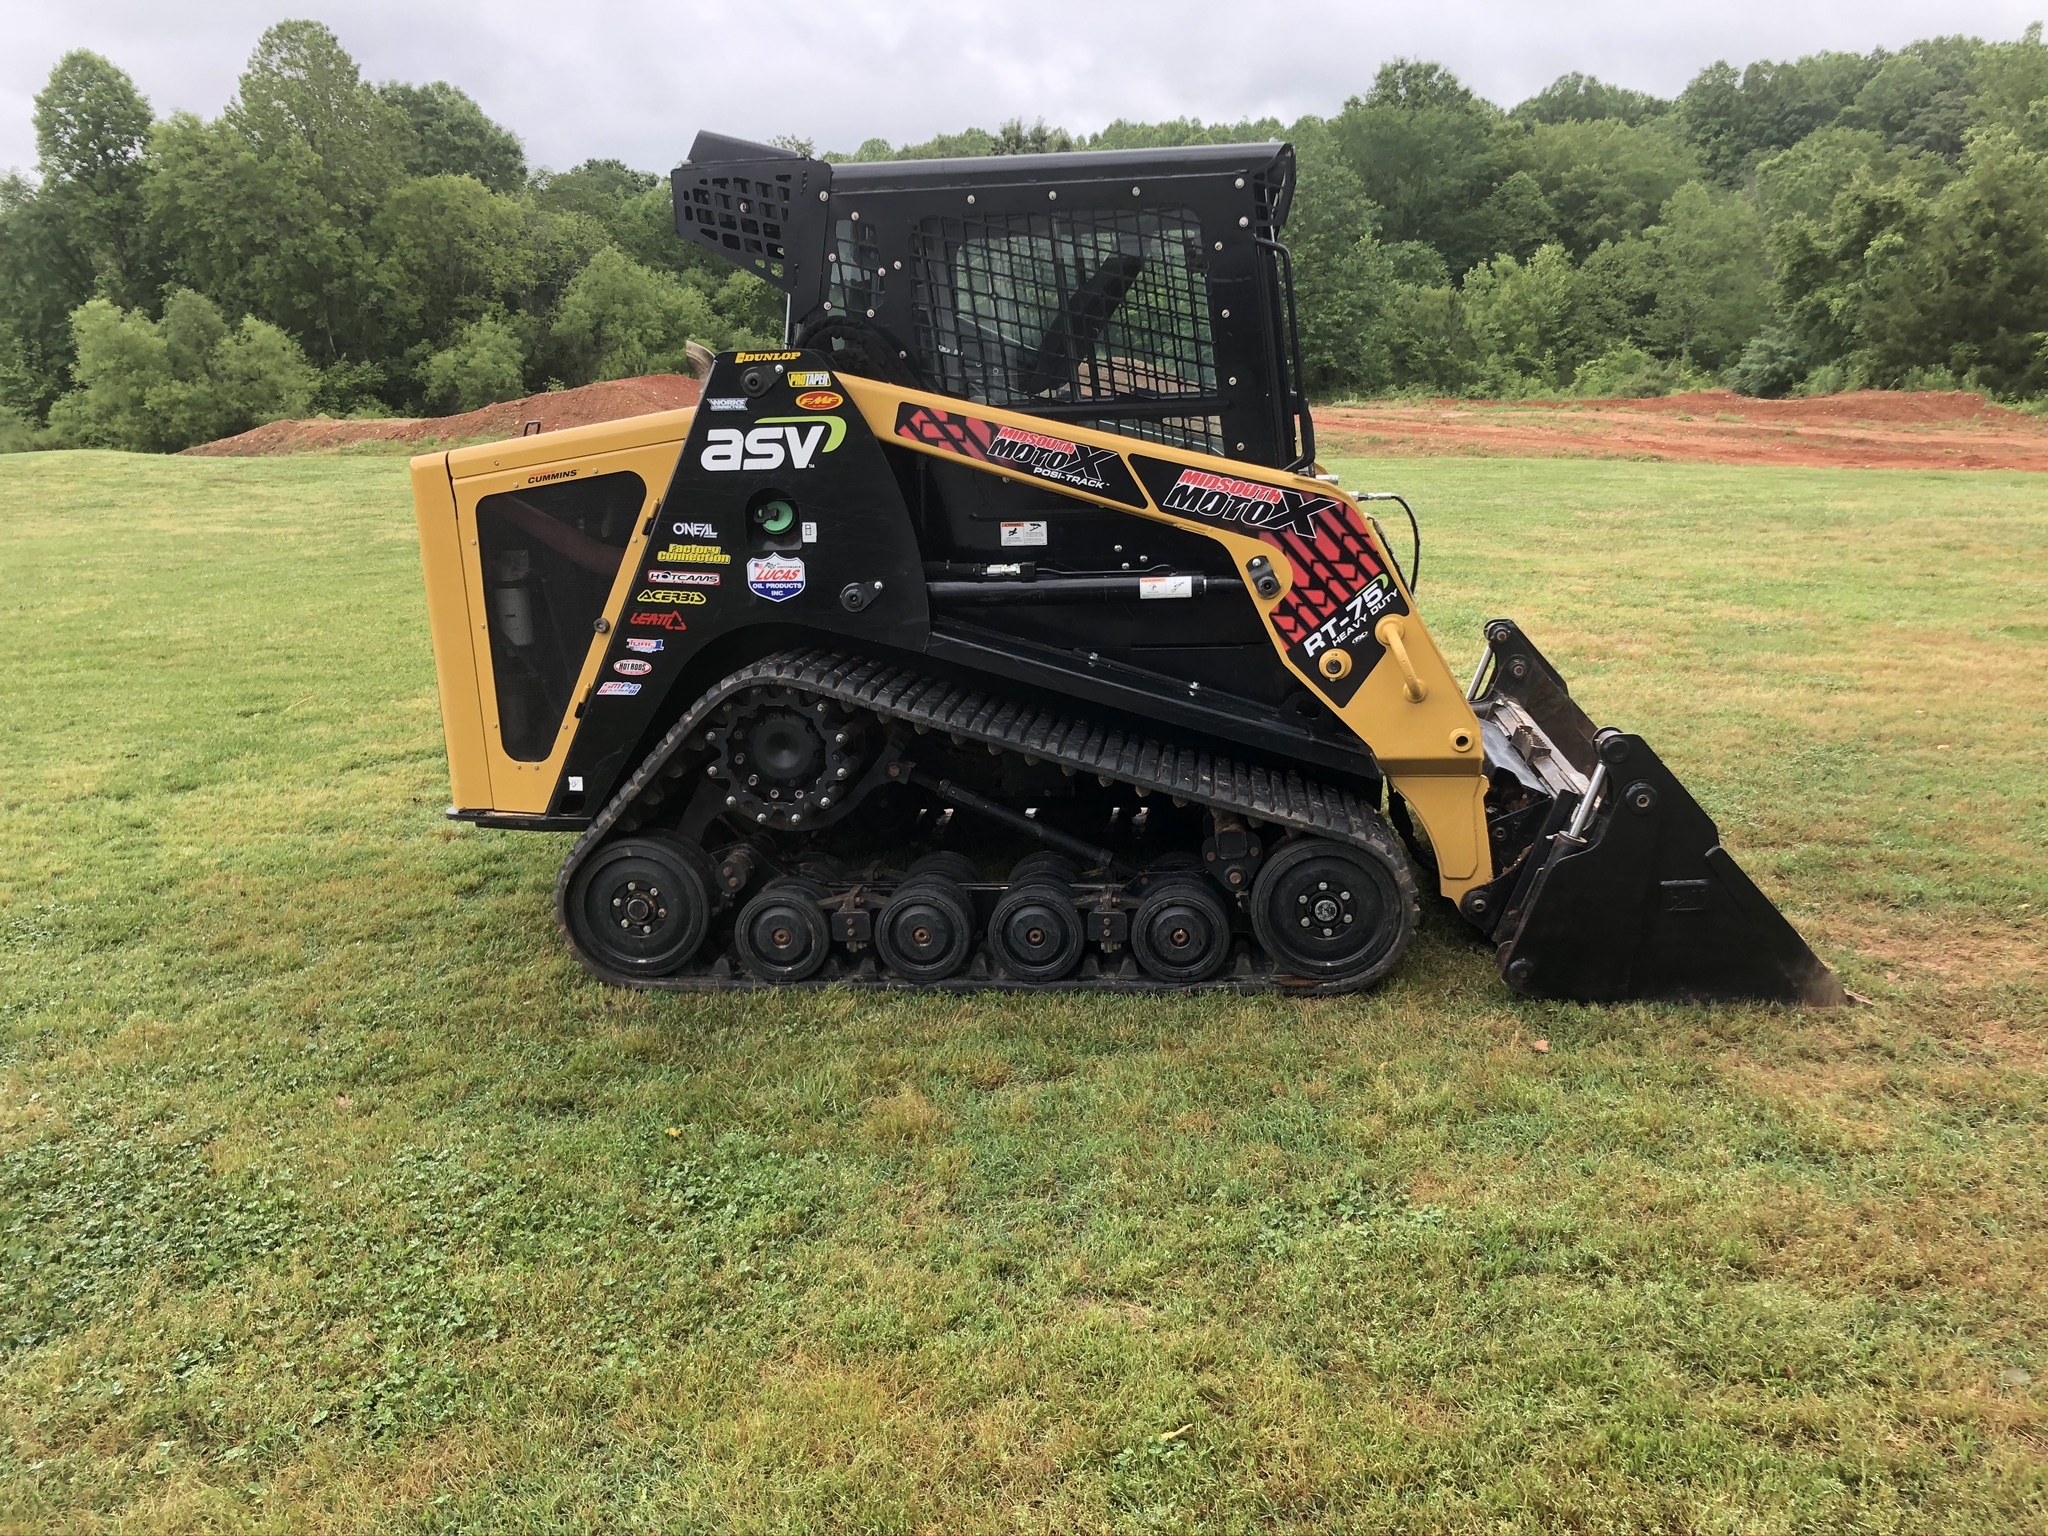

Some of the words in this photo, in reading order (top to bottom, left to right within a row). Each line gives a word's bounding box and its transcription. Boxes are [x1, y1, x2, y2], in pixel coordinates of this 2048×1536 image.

[742, 352, 801, 362] DUNLOP
[800, 396, 838, 405] FMF
[1000, 426, 1076, 454] MIDSOUTH
[527, 470, 578, 484] CUMMINS
[1033, 466, 1104, 489] POSI-TRACK
[1178, 469, 1284, 504] MIDSOUTH
[669, 544, 721, 555] Factory
[657, 551, 731, 564] Connection
[755, 569, 801, 580] LUCAS
[1303, 582, 1383, 658] RT-75
[1332, 613, 1367, 647] HEAVY
[1370, 588, 1398, 616] DUTY
[619, 662, 630, 671] HOT
[630, 663, 647, 672] RODS
